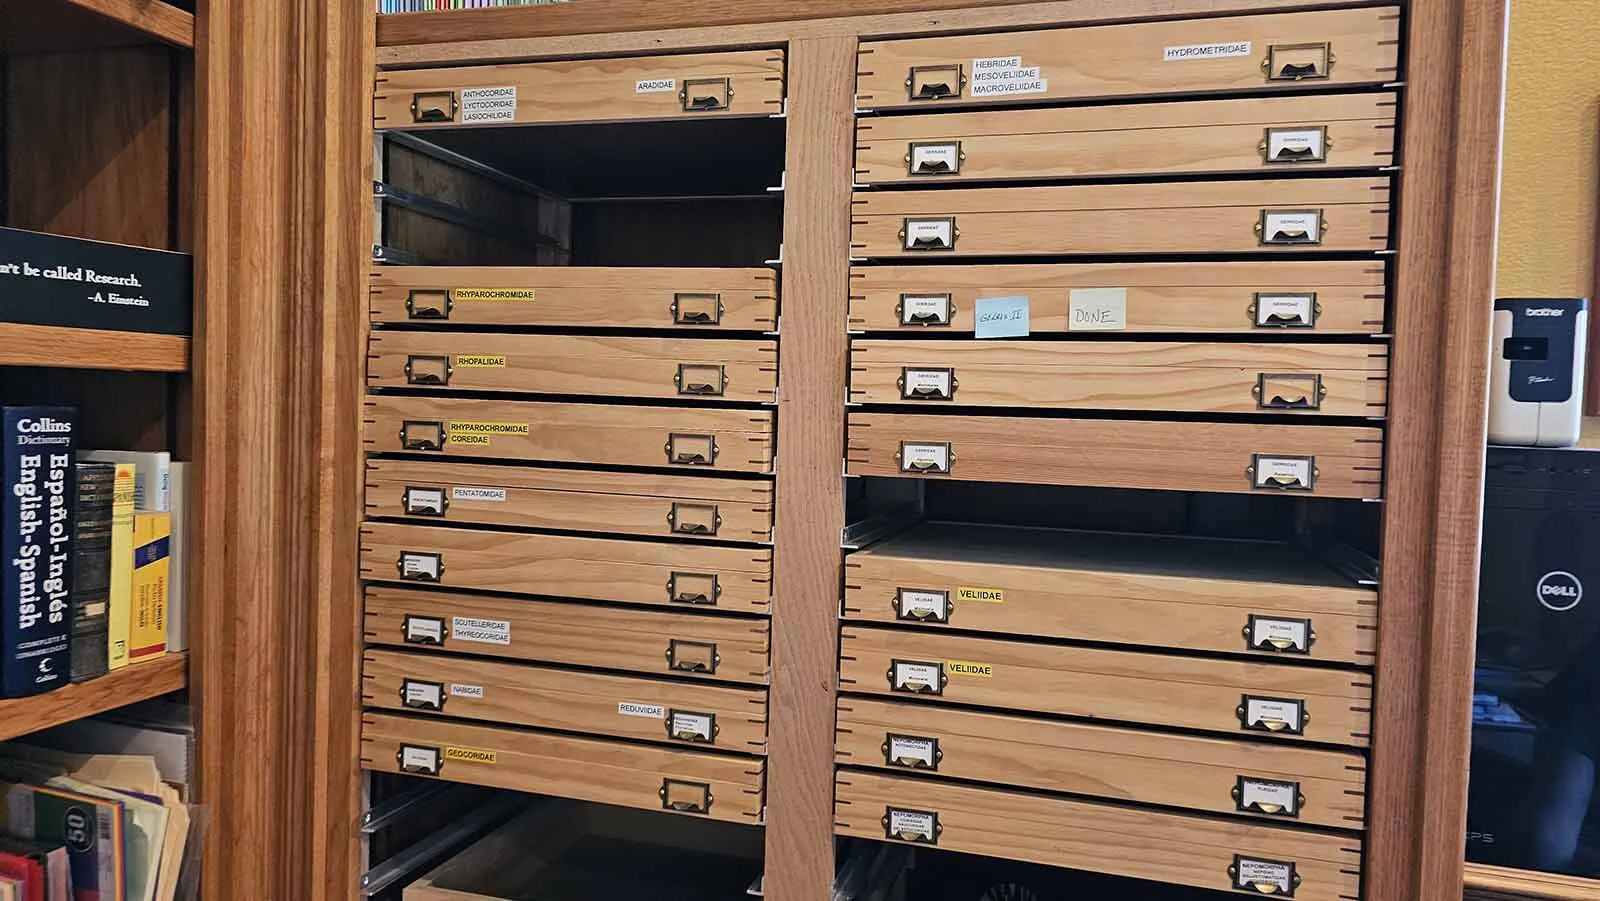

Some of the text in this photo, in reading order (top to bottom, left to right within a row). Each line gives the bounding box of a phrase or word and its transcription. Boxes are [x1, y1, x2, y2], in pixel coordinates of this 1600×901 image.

[1167, 44, 1247, 57] HYDROMETRIDAE
[975, 59, 1017, 68] HEBRIDAE
[974, 69, 1035, 81] MESOVELIIDAE
[638, 80, 673, 90] ARADIDAE
[973, 81, 1041, 94] MACROVELIIDAE
[463, 88, 513, 98] ANTHOCORIDAE
[464, 100, 513, 110] LYCTOCORIDAE
[464, 111, 512, 121] LASIOCHILIDAE
[23, 262, 40, 277] be
[43, 266, 82, 281] called
[85, 270, 142, 287] Research.
[108, 293, 149, 306] Einstein
[456, 290, 533, 299] RHYPAROCHROMIDAE
[1074, 307, 1117, 324] DONE
[1525, 307, 1565, 317] brother
[458, 357, 504, 366] RHOPALIDAE
[17, 418, 72, 433] Collins
[451, 423, 528, 434] RHYPAROCHROMIDAE
[16, 435, 71, 447] Dictionary
[451, 435, 488, 444] COREIDAE
[454, 489, 504, 498] PENTATOMIDAE
[12, 454, 43, 629] English-Spanish
[43, 454, 69, 624] Español-Inglés
[960, 590, 1002, 600] VELIIDAE
[1542, 585, 1577, 597] DELL
[454, 619, 505, 629] SCUTELLERIDAE
[455, 630, 509, 641] THYREOCORIDAE
[949, 664, 991, 675] VELIIDAE
[453, 686, 481, 695] NABIDAE
[620, 704, 662, 715] REDUVIIDAE
[447, 749, 495, 761] GEOCORIDAE
[68, 815, 85, 843] 50
